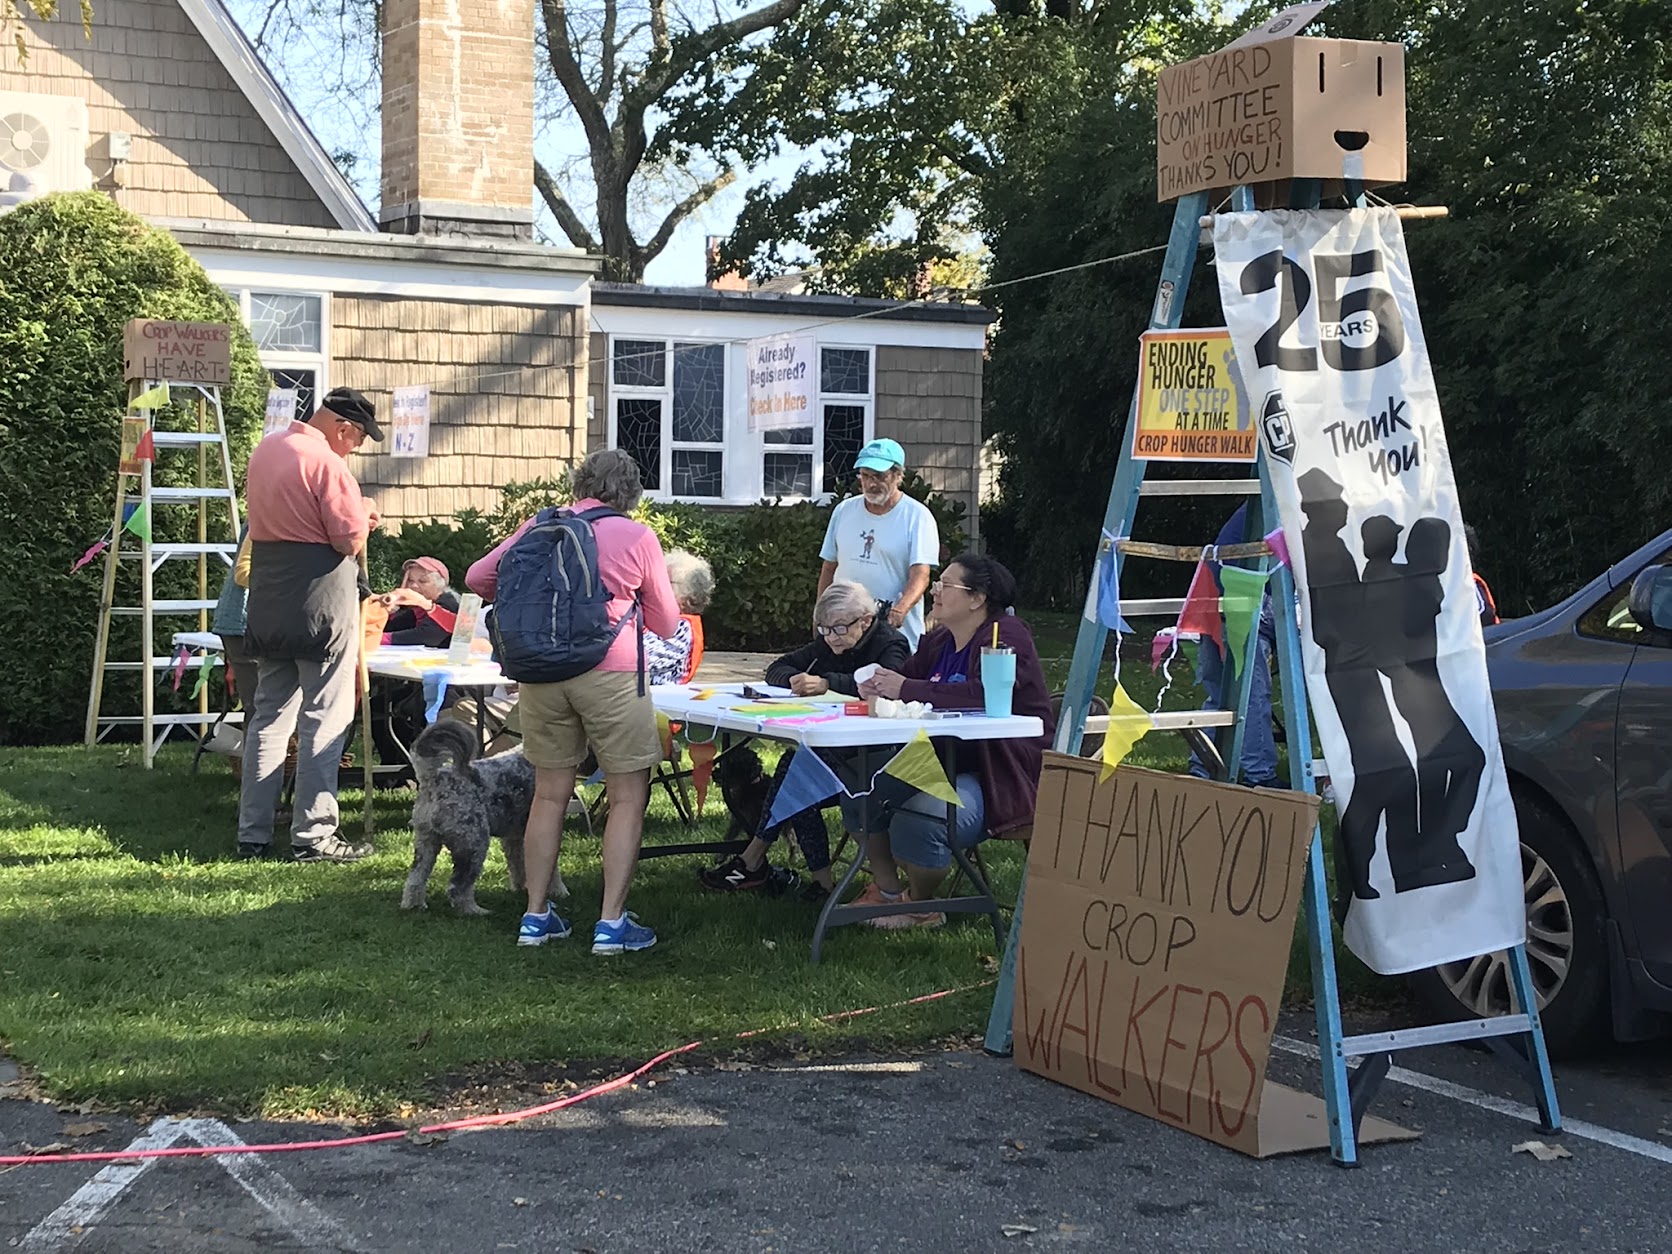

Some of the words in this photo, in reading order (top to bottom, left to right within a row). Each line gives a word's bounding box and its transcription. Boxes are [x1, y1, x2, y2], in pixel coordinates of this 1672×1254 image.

[1160, 46, 1271, 105] VINEYARD
[1160, 84, 1280, 145] COMMITTEE
[1183, 137, 1201, 161] ON
[1203, 117, 1282, 156] HUNGER
[1160, 156, 1217, 195] THANKS
[1223, 142, 1282, 180] YOU!
[1240, 249, 1405, 371] 25
[174, 324, 228, 341] WALKERS
[1319, 319, 1374, 339] YEARS
[158, 342, 206, 357] HAVE
[758, 343, 796, 364] Already
[1149, 341, 1208, 369] ENDING
[1151, 365, 1216, 389] HUNGER
[784, 392, 807, 411] Here
[1159, 388, 1191, 413] ONE
[1194, 388, 1230, 413] STEP
[1175, 412, 1188, 430] AT
[1191, 412, 1200, 430] A
[1202, 412, 1230, 430] TIME
[1138, 435, 1168, 452] CROP
[1170, 435, 1217, 453] HUNGER
[1220, 435, 1253, 454] WALK
[1043, 763, 1211, 906] THANK
[1210, 800, 1297, 922] YOU
[1082, 900, 1197, 972] CROP
[1021, 946, 1270, 1137] WALKERS
